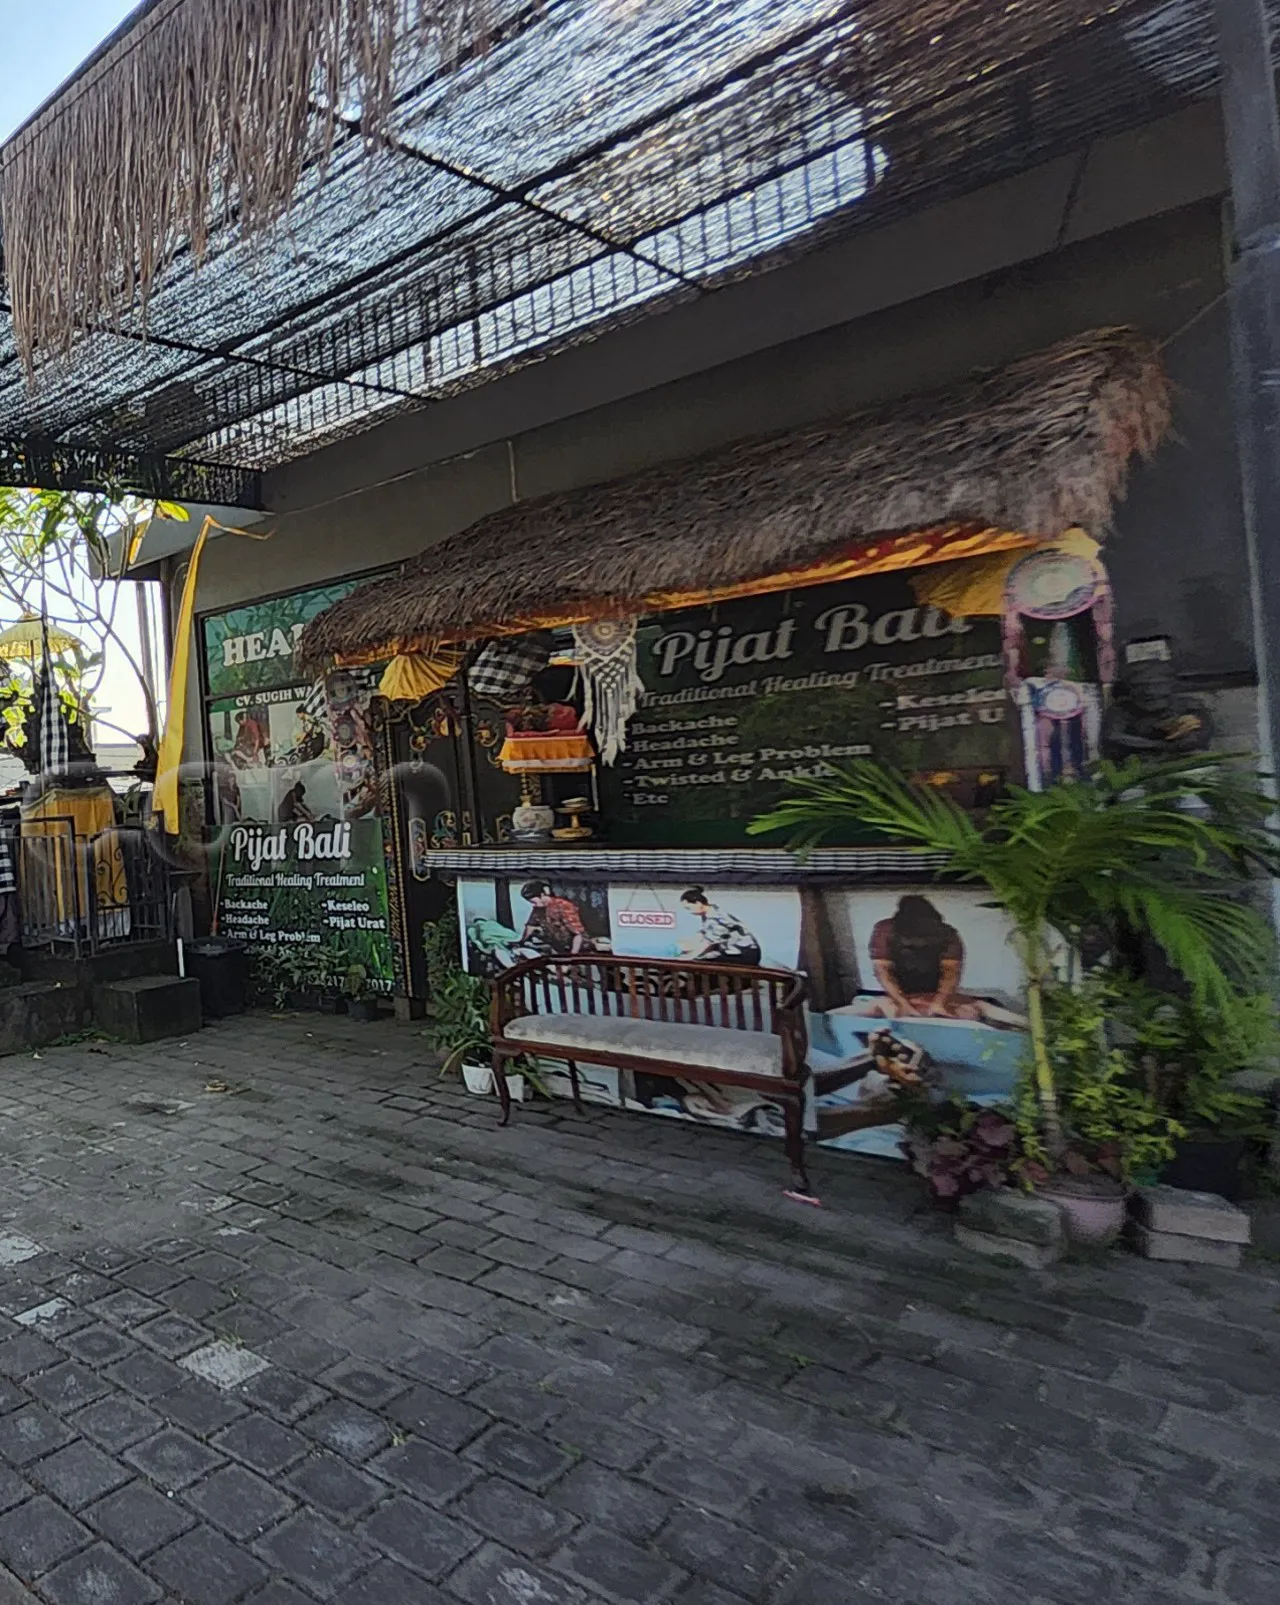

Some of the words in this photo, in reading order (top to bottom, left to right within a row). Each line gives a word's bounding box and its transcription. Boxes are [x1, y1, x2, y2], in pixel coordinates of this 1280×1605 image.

[652, 619, 799, 682] Pijat
[236, 694, 254, 708] CV.
[255, 690, 293, 704] SUGIH
[639, 681, 757, 709] Traditional
[761, 671, 861, 696] Healing
[687, 753, 709, 767] &
[713, 751, 756, 766] Leg
[759, 743, 873, 763] Problem
[730, 768, 752, 782] &
[231, 827, 288, 872] Pijat
[293, 822, 352, 860] Bali
[226, 873, 274, 888] Traditional
[275, 872, 313, 891] Healing
[314, 872, 365, 887] Treatment
[357, 917, 387, 930] Urat
[620, 913, 673, 926] CLOSED
[249, 930, 258, 940] &
[259, 930, 276, 944] Leg
